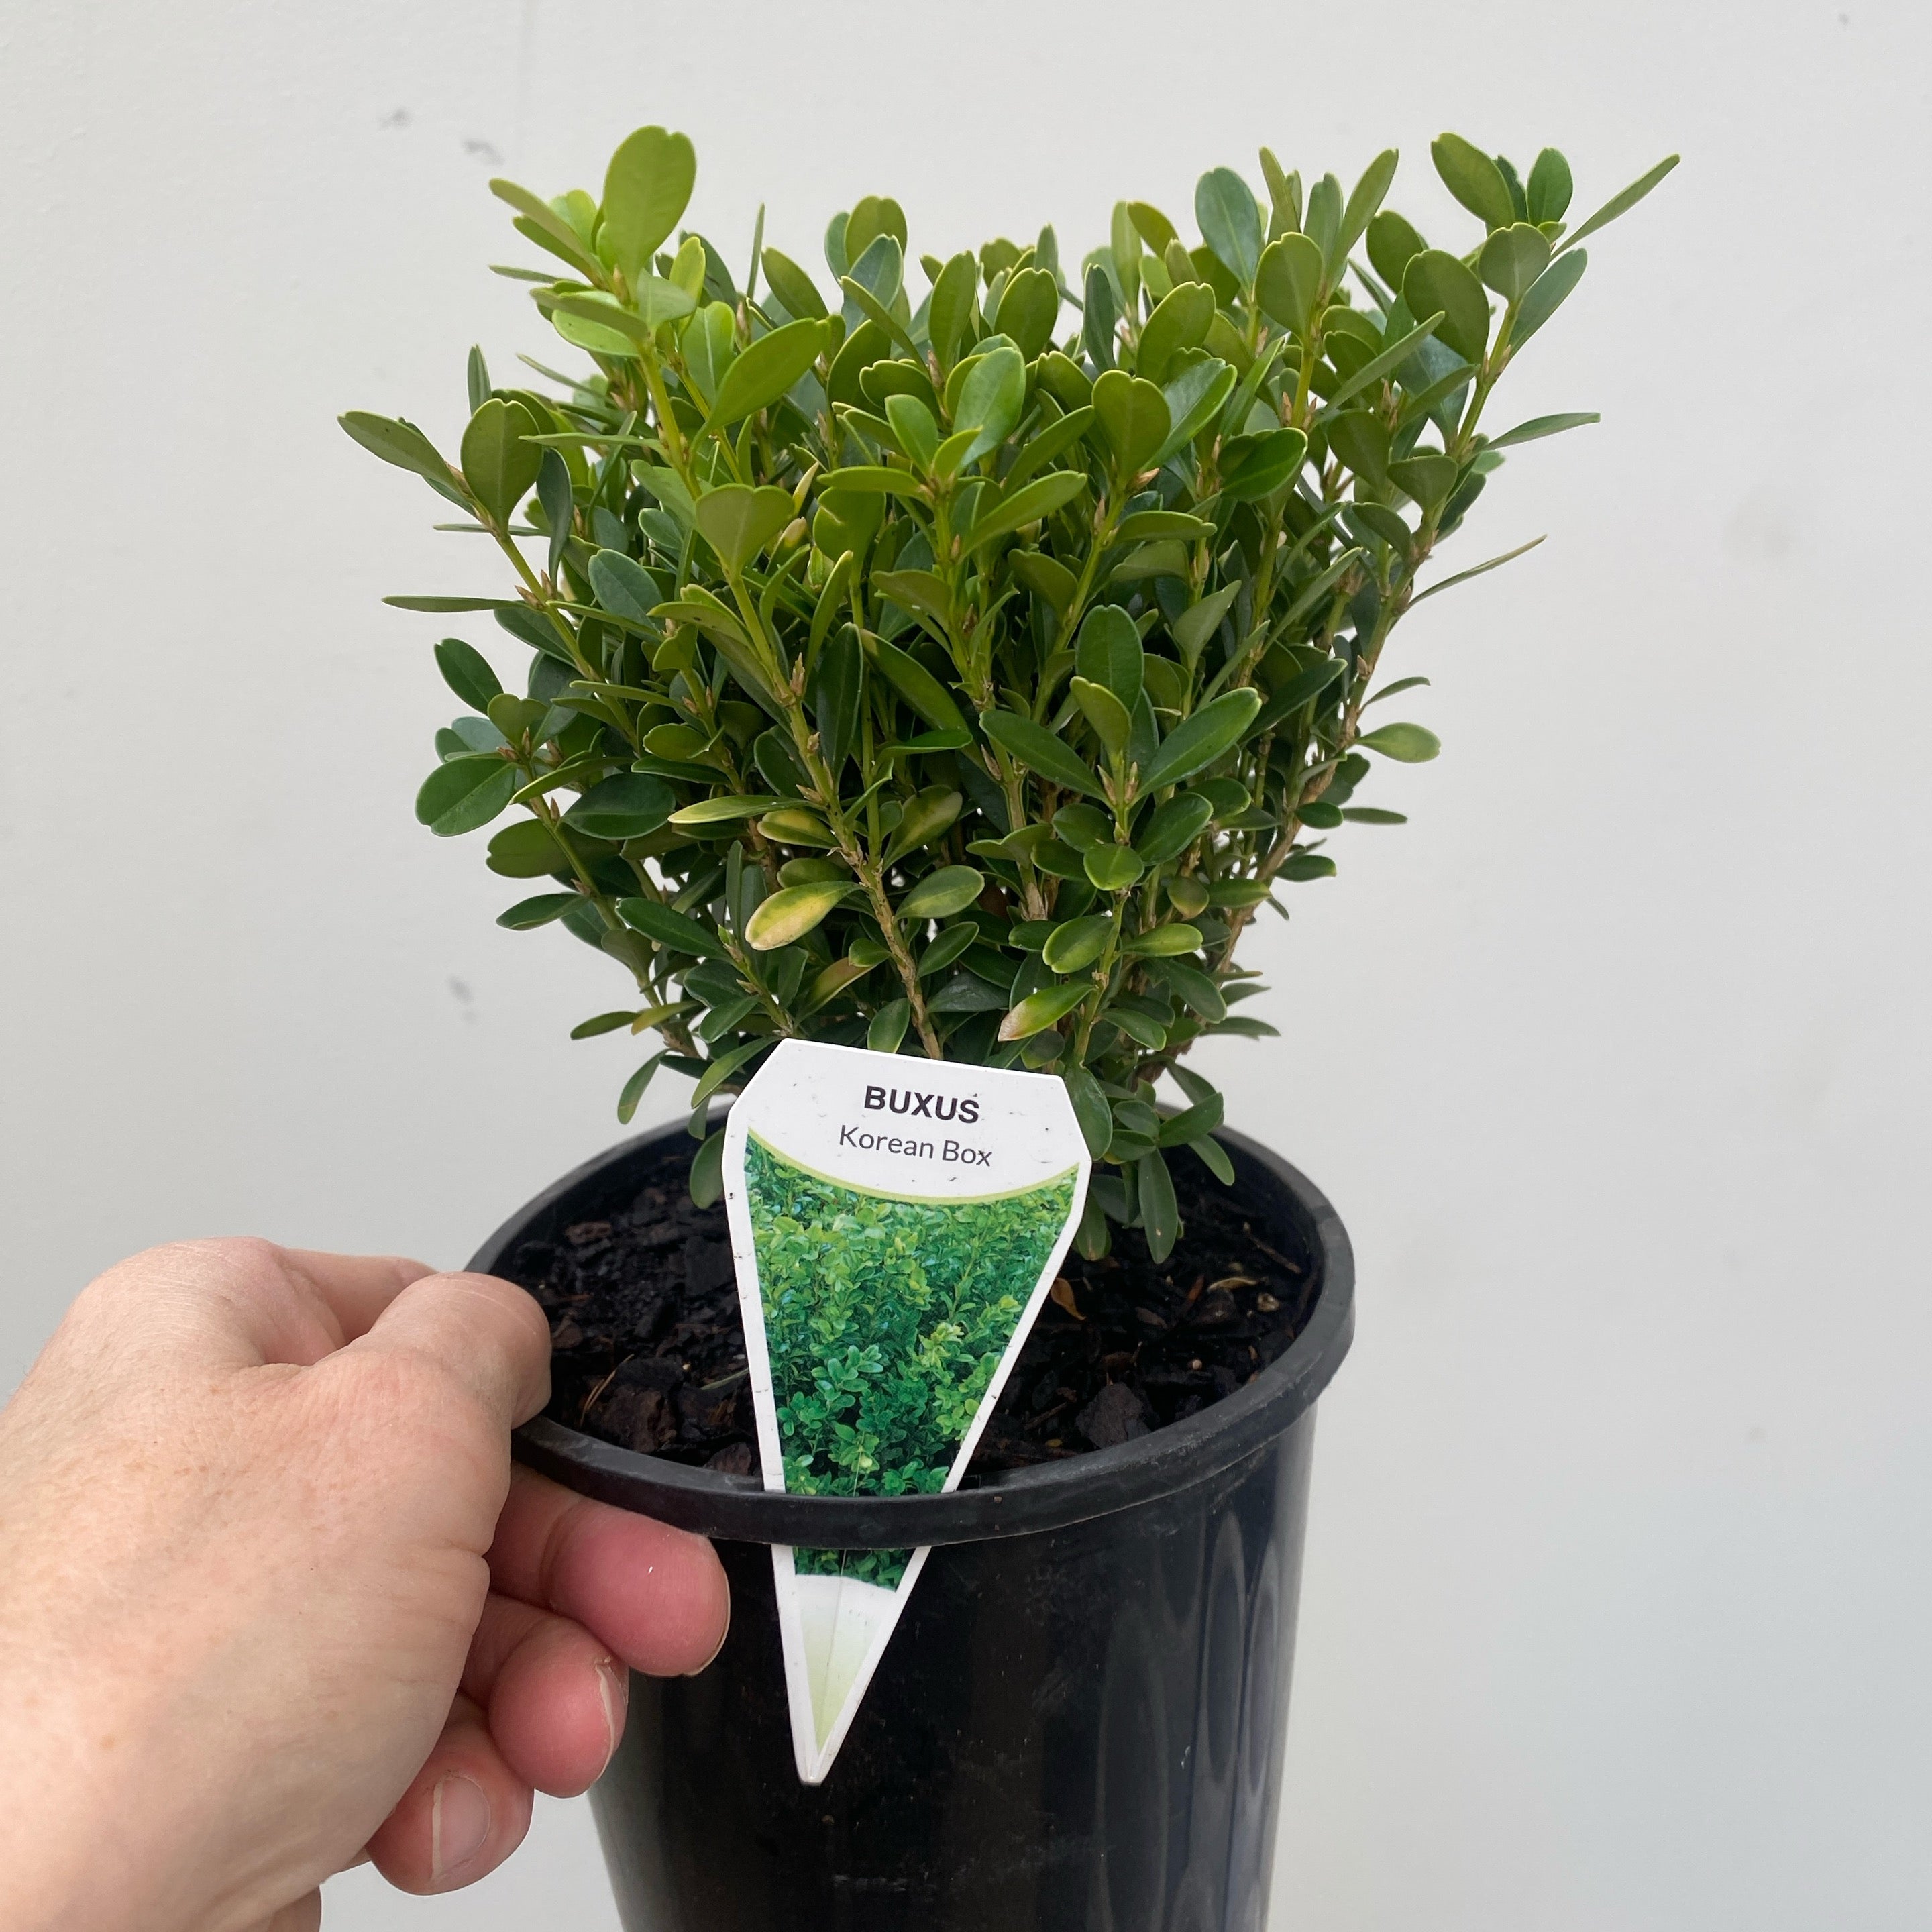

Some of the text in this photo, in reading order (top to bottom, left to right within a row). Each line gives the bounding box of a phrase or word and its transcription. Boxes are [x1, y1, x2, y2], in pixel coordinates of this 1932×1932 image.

[864, 1085, 980, 1124] BUXUS
[839, 1124, 992, 1167] Korean Box
